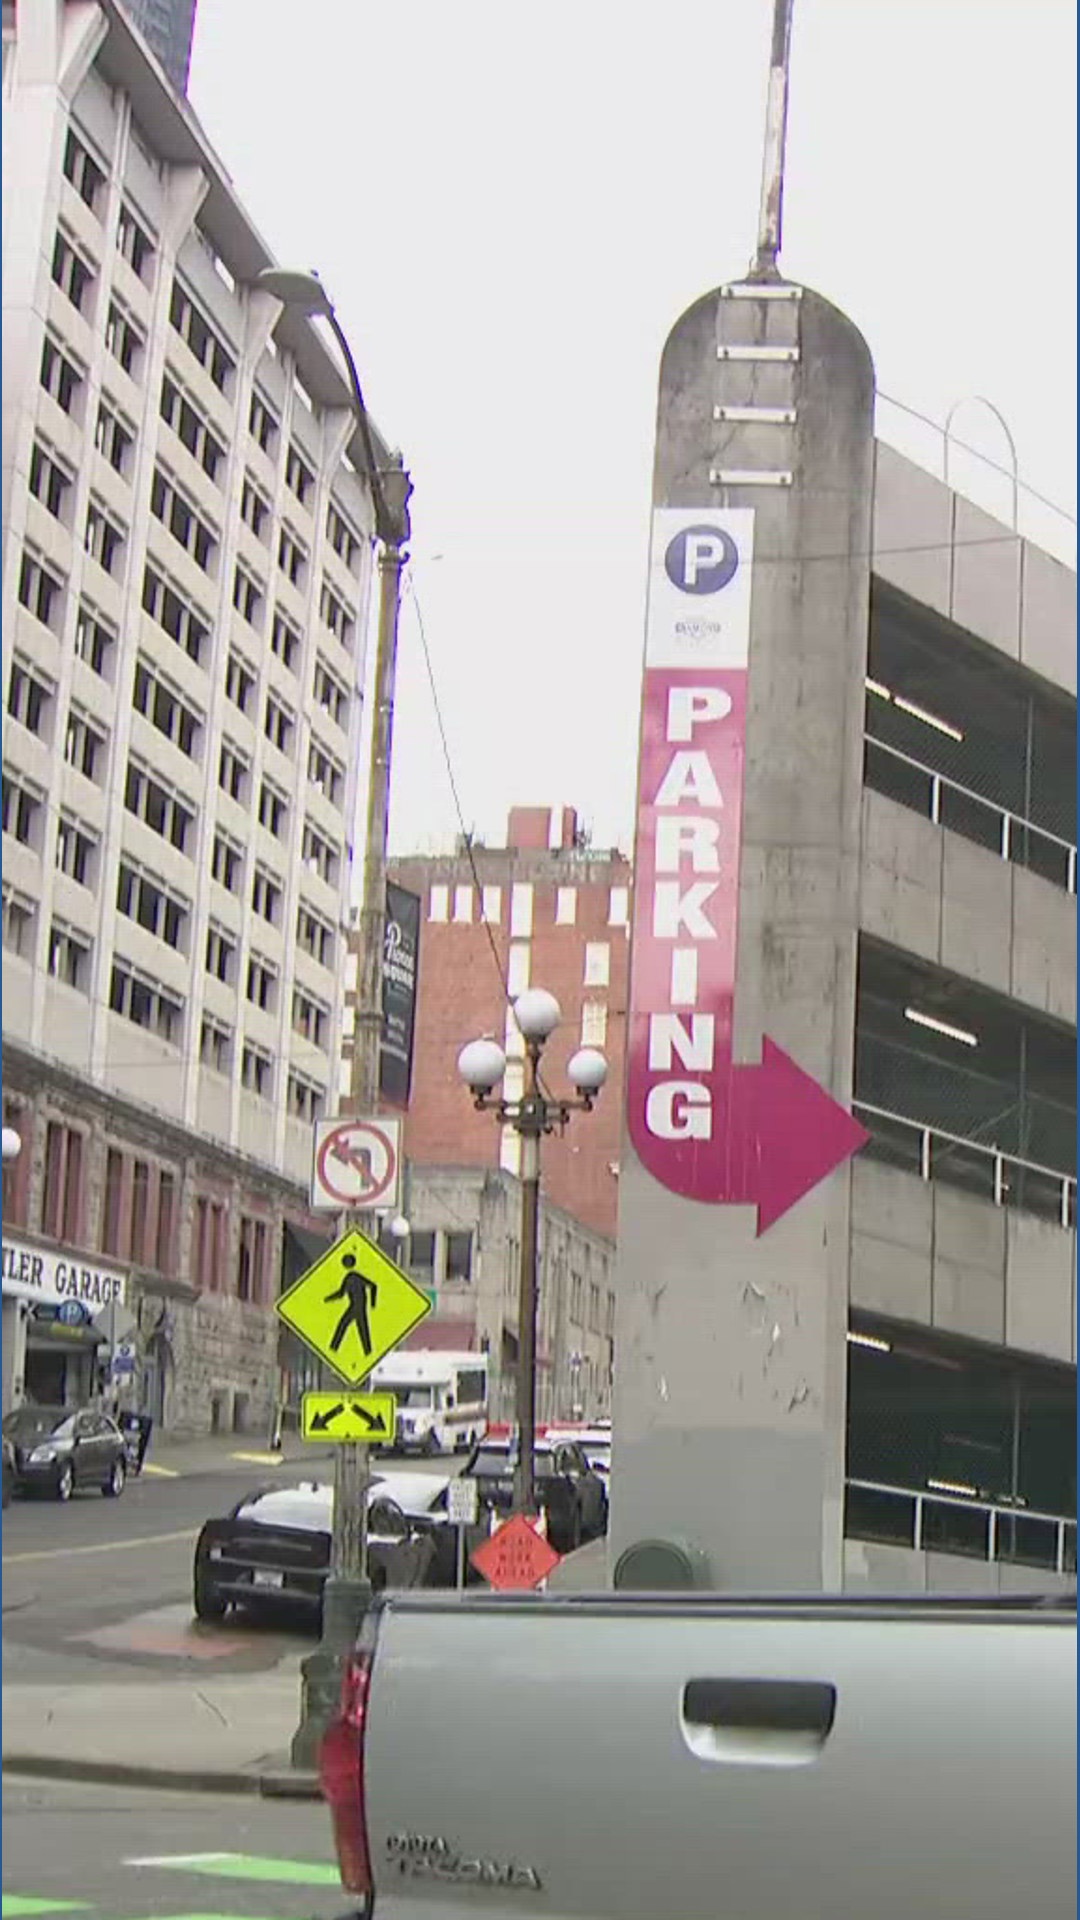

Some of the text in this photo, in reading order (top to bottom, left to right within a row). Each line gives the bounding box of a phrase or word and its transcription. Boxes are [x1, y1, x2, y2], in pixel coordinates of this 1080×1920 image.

[684, 533, 724, 586] P
[645, 686, 733, 1141] PARKING
[55, 1262, 120, 1306] GARAGE
[385, 1856, 543, 1889] TACOMA
